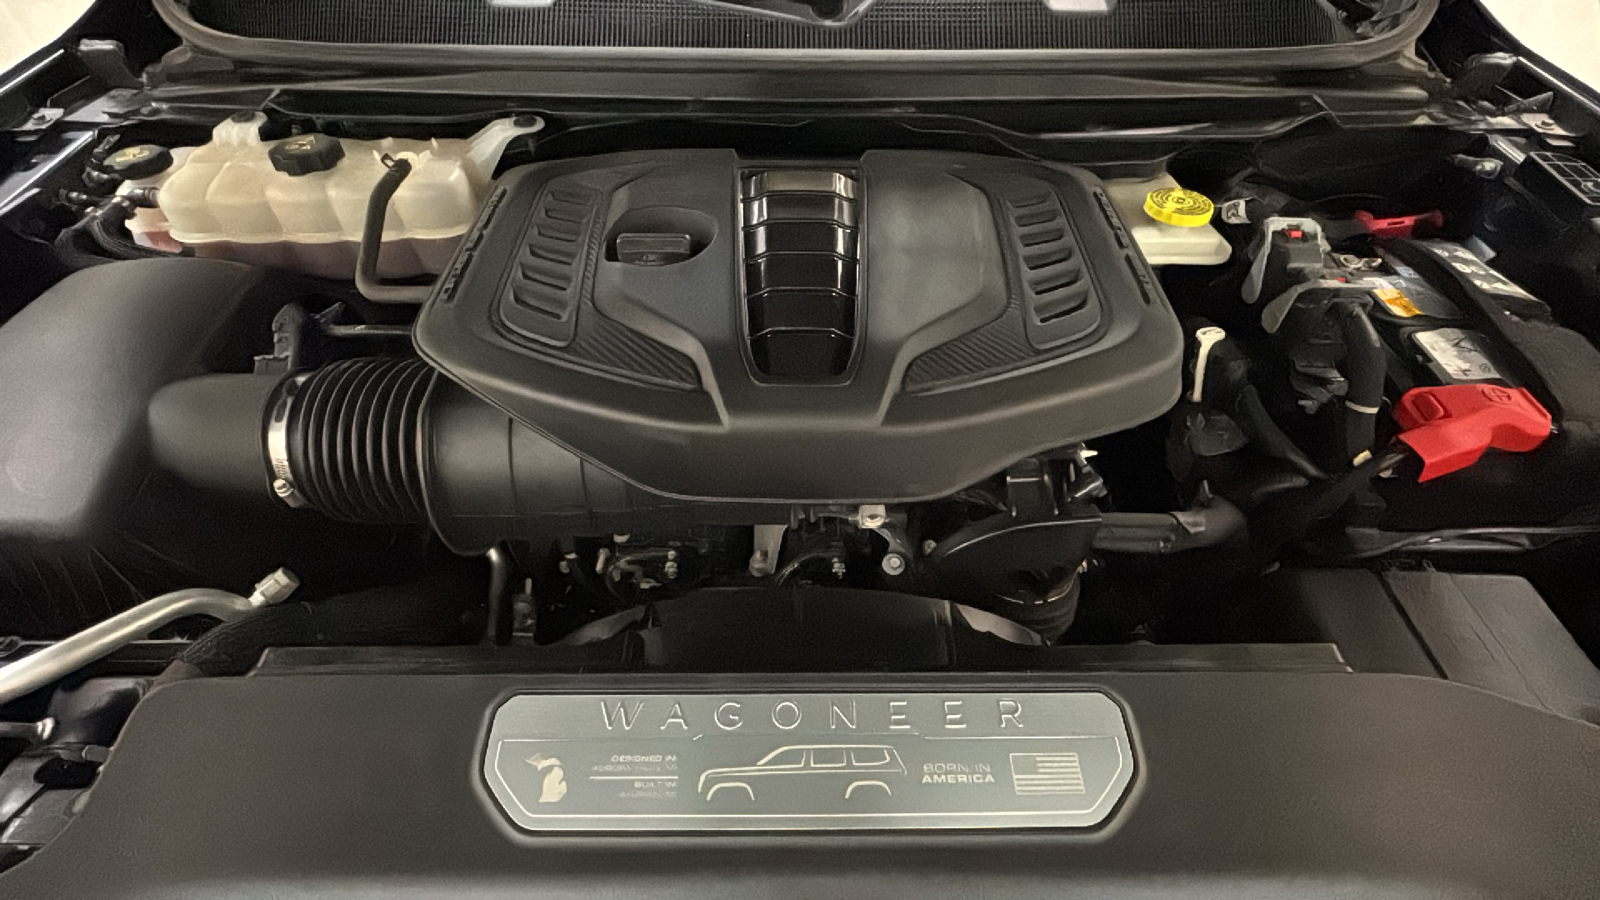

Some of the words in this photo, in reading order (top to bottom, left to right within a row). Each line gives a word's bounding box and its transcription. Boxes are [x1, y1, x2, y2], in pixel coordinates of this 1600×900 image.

[600, 700, 1024, 730] WAGONEER
[610, 754, 662, 763] DESIGNED
[923, 762, 969, 773] BORN
[975, 762, 991, 773] IN
[921, 774, 995, 783] AMERICA
